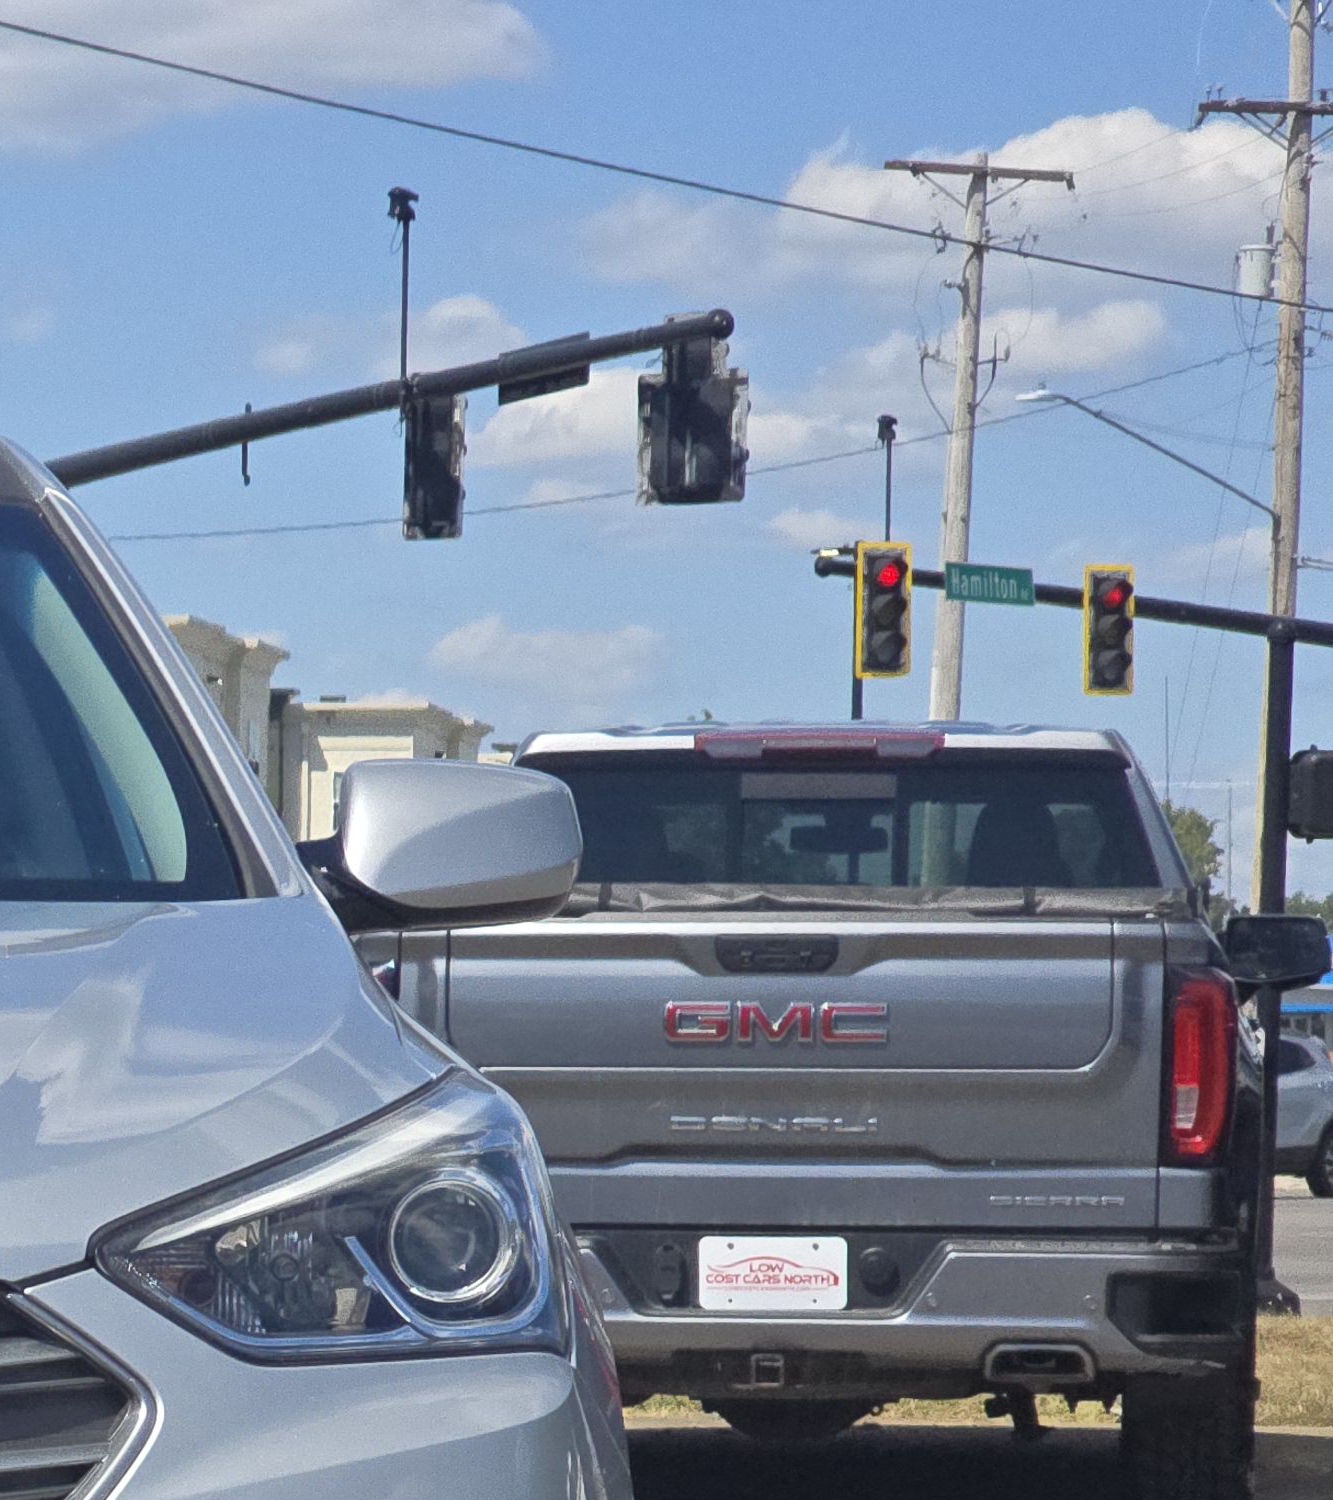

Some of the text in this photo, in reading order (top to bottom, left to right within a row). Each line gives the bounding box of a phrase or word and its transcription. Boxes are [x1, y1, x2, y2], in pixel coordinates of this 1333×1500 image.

[951, 567, 1018, 599] Hamilton
[664, 1000, 888, 1043] GMC
[670, 1115, 878, 1132] DENALI
[989, 1195, 1126, 1206] SIERRA
[749, 1262, 784, 1273] LOW
[705, 1273, 830, 1285] COST CARS NORTH
